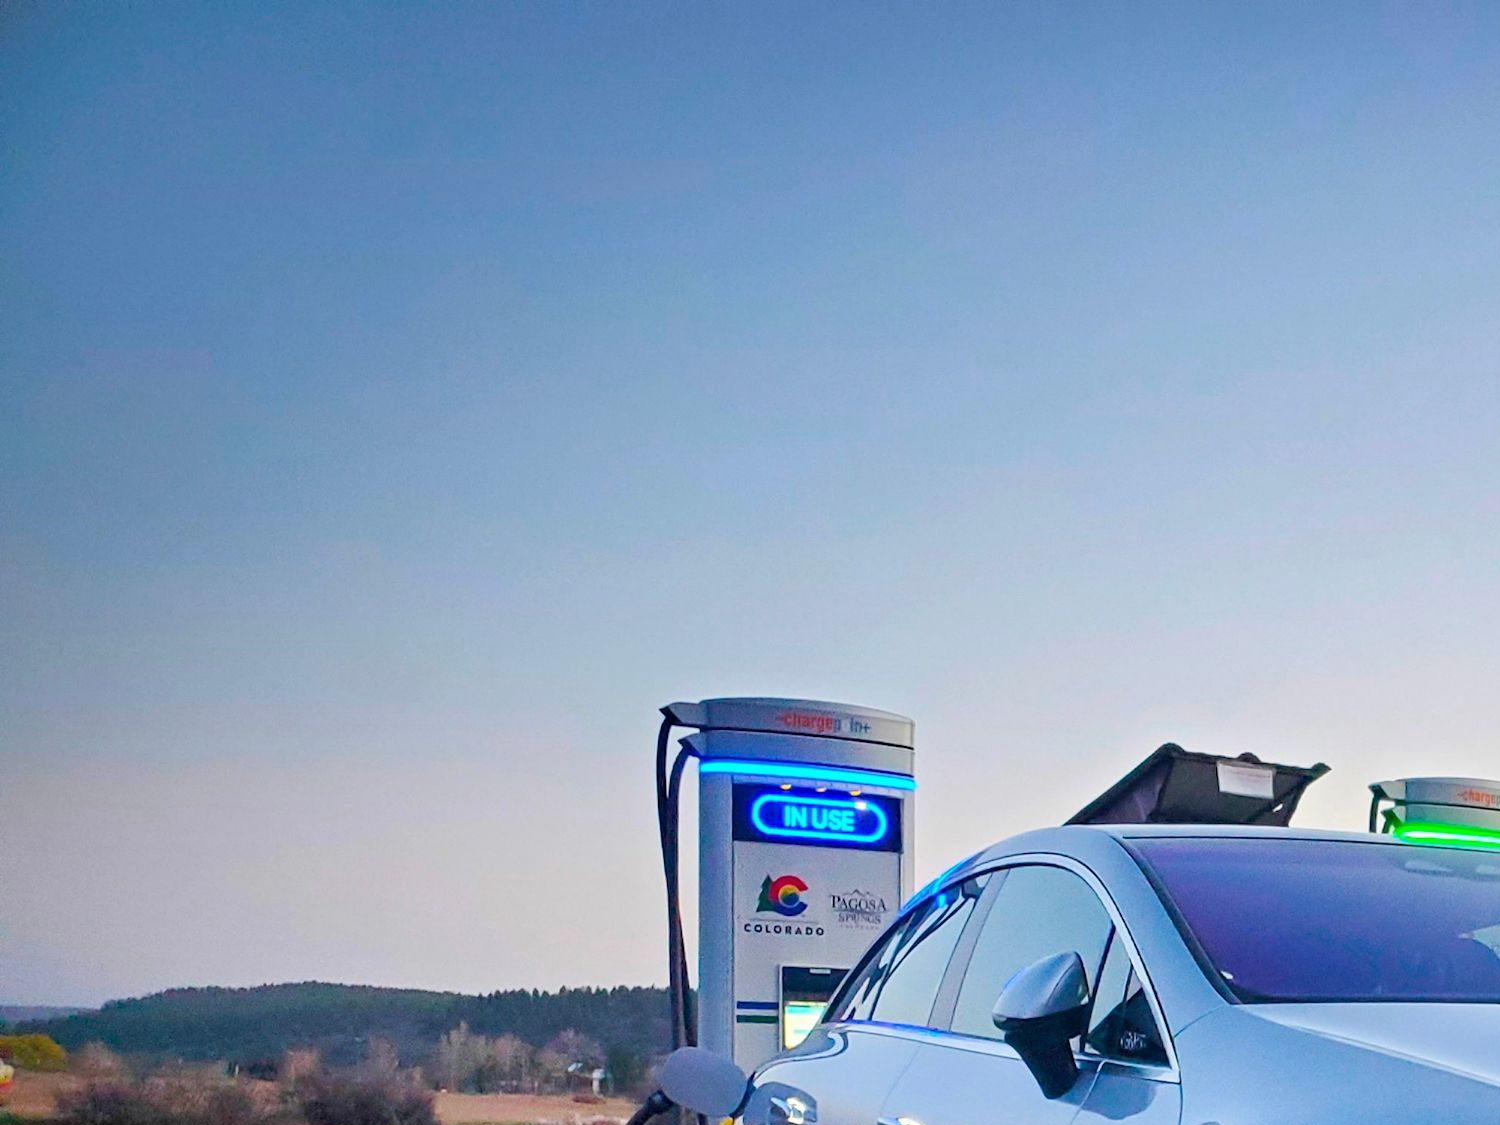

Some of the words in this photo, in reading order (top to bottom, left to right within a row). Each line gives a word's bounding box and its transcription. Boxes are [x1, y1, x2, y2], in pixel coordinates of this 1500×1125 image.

[781, 711, 871, 734] chargepint
[784, 805, 807, 828] IN
[811, 808, 855, 832] USE
[831, 894, 887, 912] PAGOSA
[744, 923, 825, 936] COLORADO
